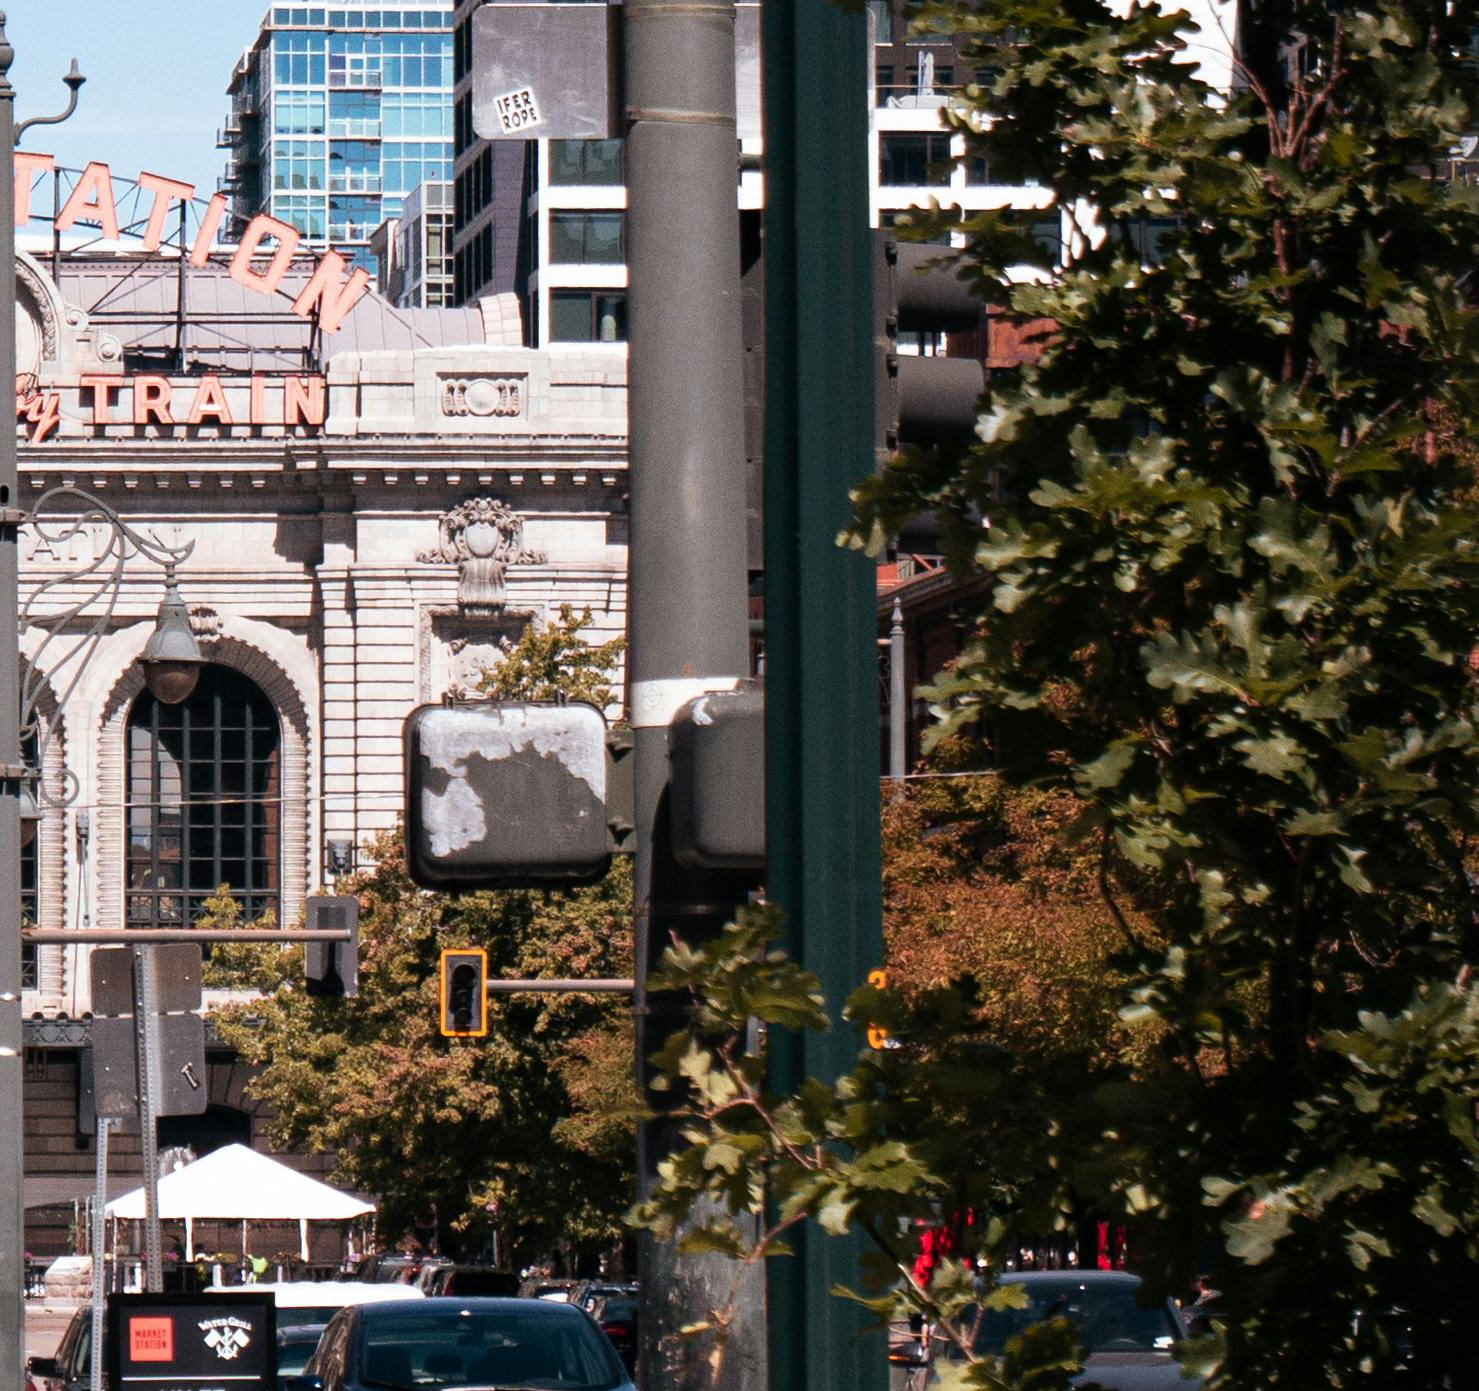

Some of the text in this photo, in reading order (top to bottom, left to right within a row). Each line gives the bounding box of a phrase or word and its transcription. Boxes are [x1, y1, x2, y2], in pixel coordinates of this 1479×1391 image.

[80, 373, 326, 425] TRAIN
[135, 1329, 167, 1339] MARKET
[135, 1339, 167, 1350] STATION
